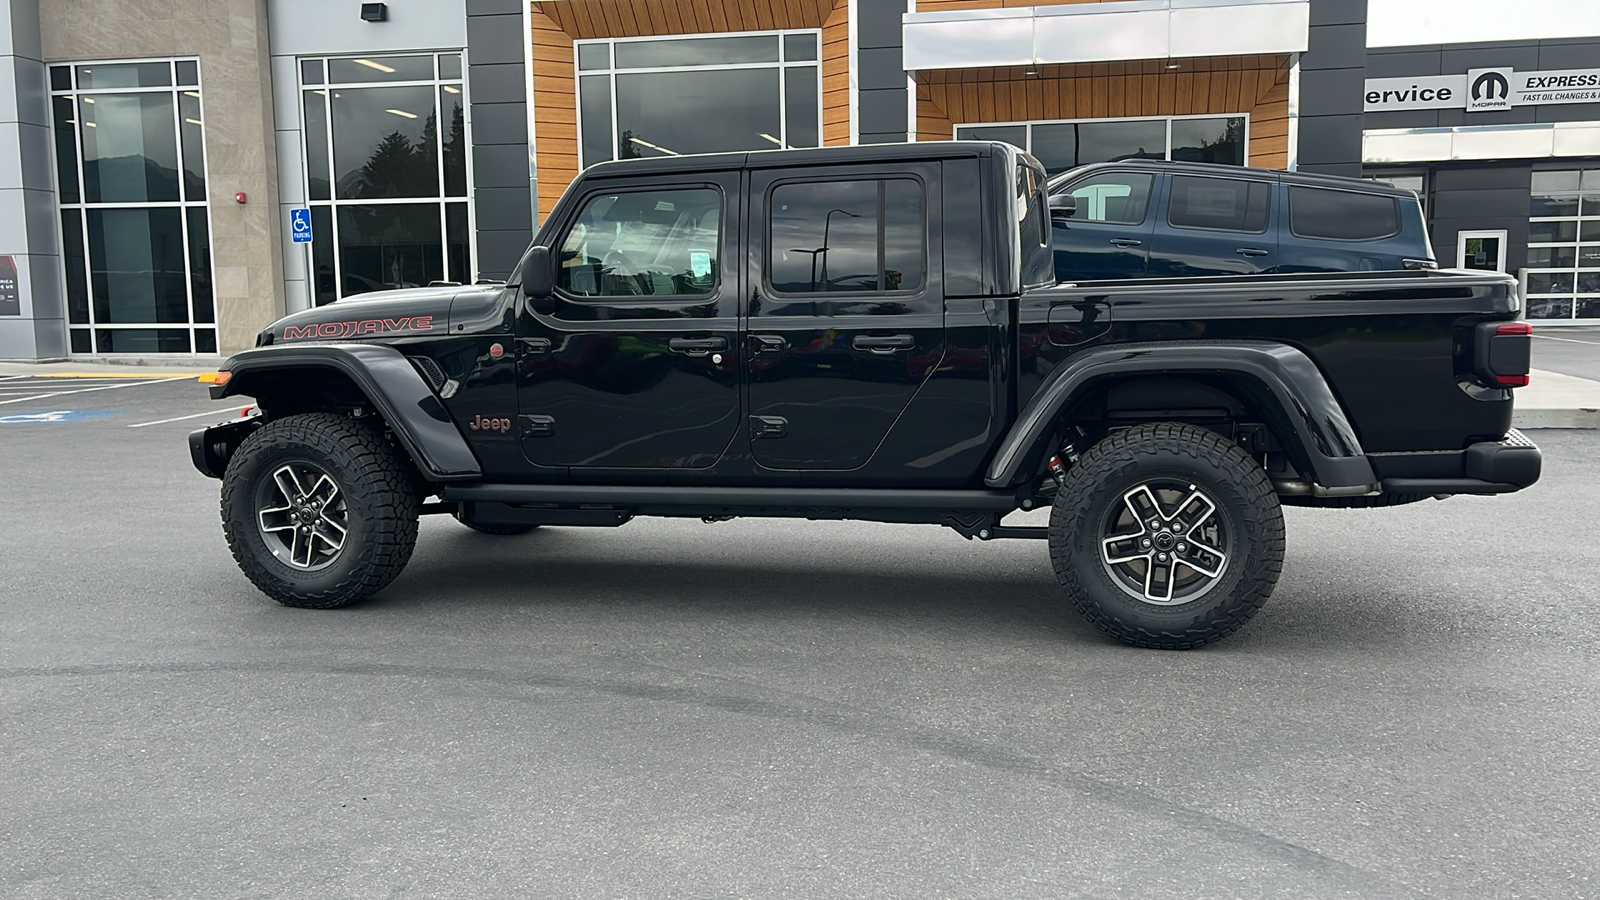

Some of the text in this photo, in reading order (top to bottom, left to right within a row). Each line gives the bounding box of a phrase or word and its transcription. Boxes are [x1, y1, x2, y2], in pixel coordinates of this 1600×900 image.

[1526, 75, 1598, 88] EXPRESS
[1555, 92, 1590, 100] CHANGES
[1590, 91, 1597, 99] &
[283, 316, 433, 340] MOJAVE
[469, 414, 511, 434] Jeep
